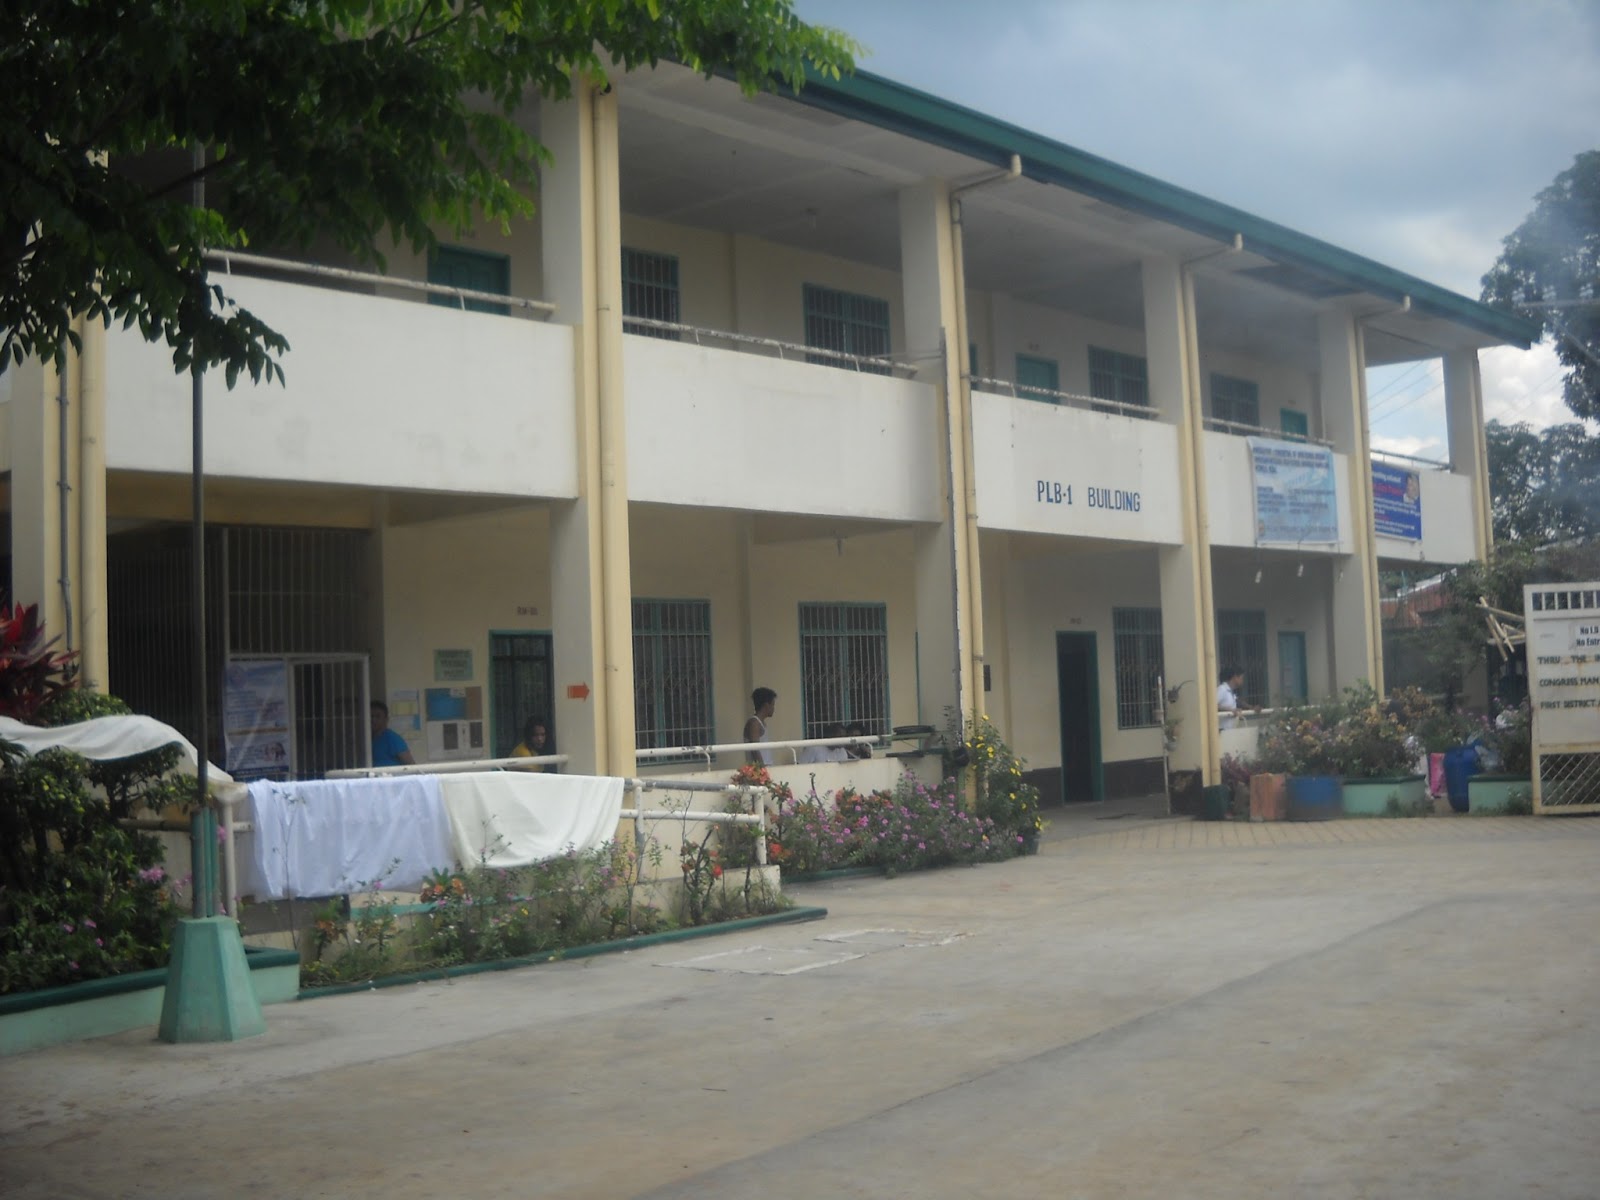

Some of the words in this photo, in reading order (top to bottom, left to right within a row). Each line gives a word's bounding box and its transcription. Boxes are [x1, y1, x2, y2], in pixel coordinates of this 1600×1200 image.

[1087, 486, 1141, 512] BUILDING
[1576, 638, 1585, 647] No
[1537, 656, 1561, 665] THRU
[1571, 654, 1586, 663] THE
[1540, 700, 1560, 710] FIRST
[1563, 698, 1596, 708] DISTRICT
